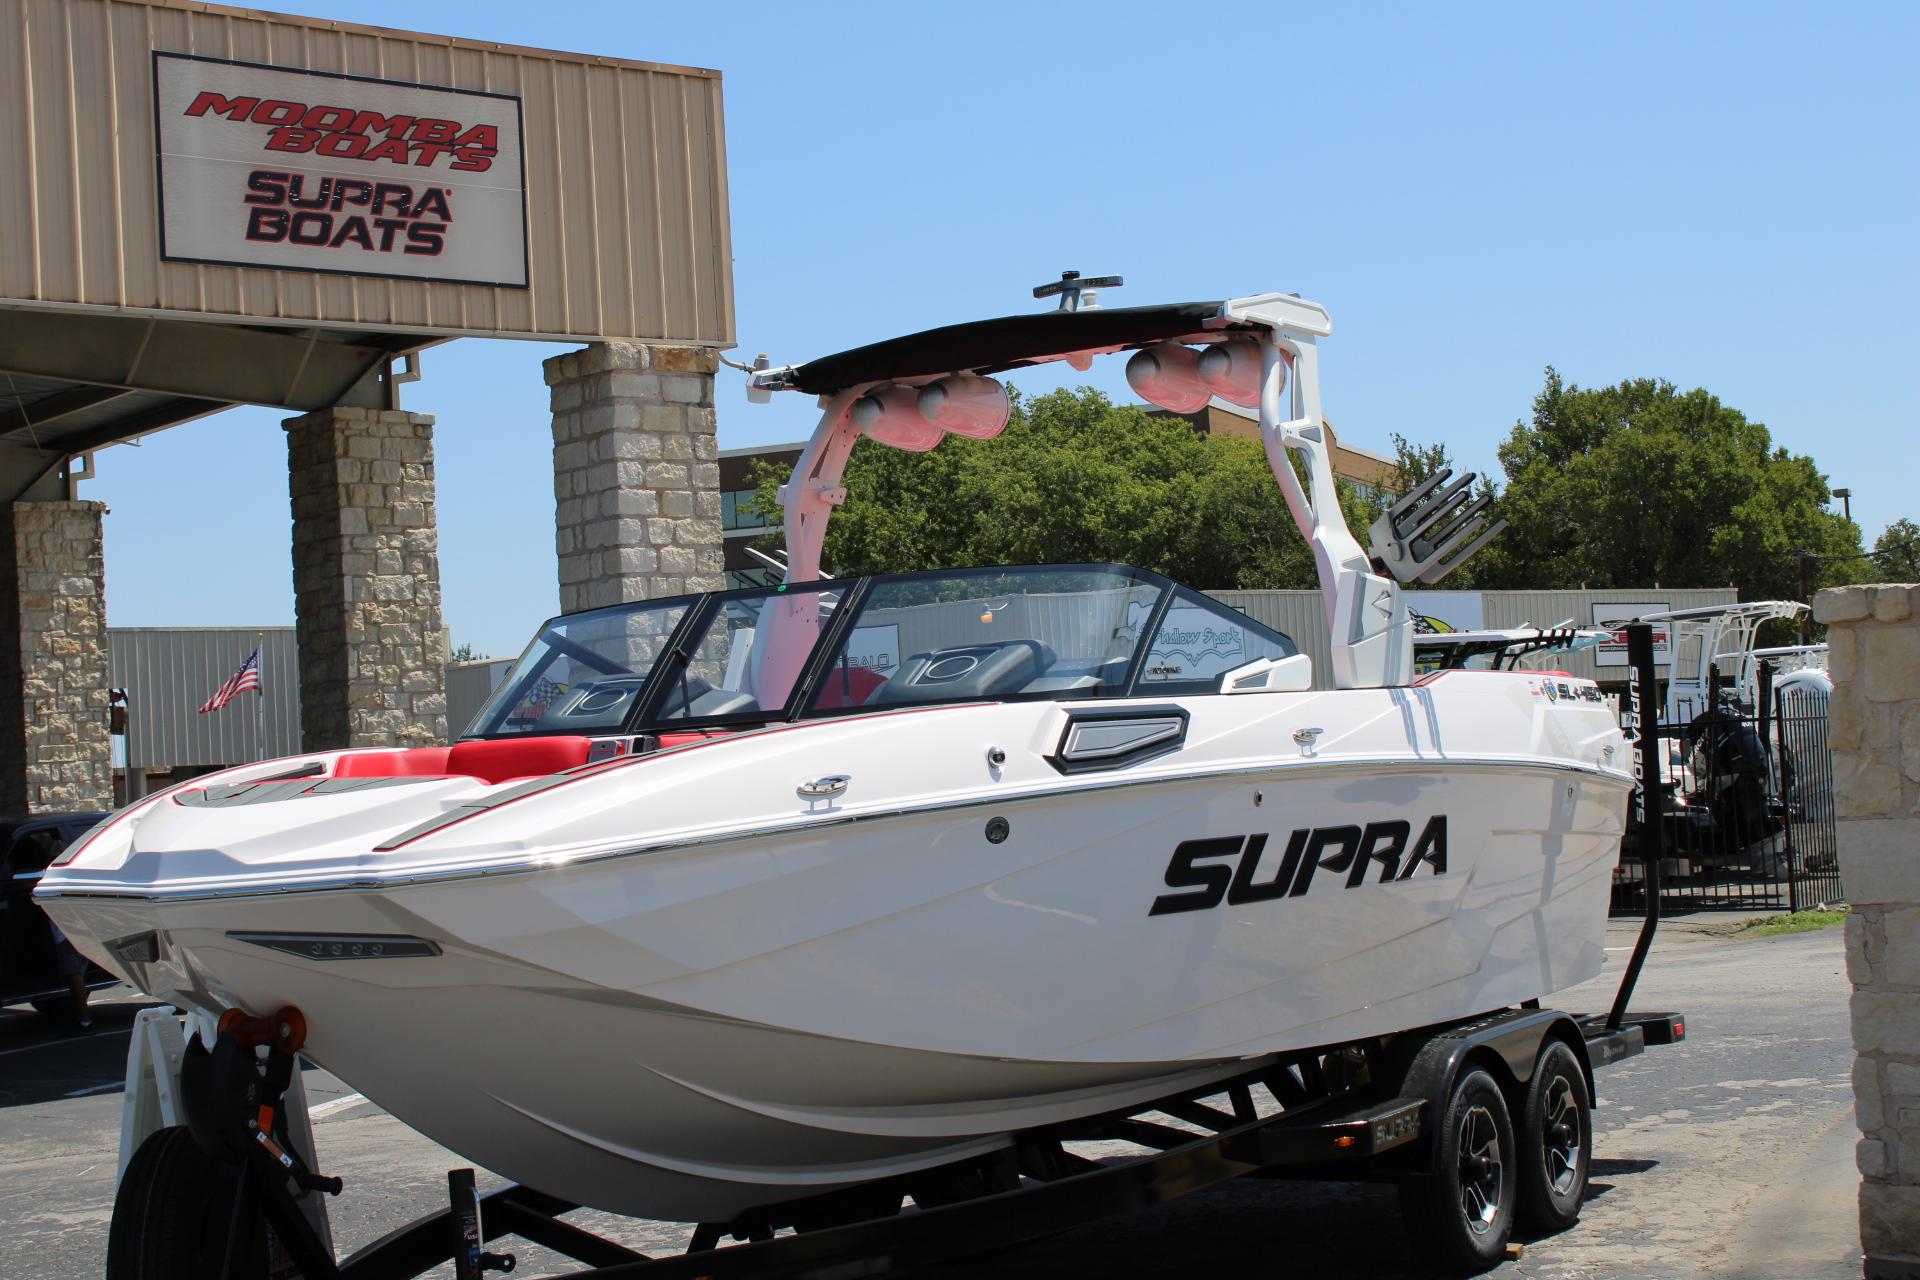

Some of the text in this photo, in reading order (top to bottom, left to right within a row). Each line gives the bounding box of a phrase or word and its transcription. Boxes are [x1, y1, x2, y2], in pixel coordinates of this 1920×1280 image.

[184, 91, 498, 150] MOOMBA
[264, 127, 498, 172] BOATS
[244, 170, 454, 222] SUPRA
[245, 207, 448, 257] BOATS
[1203, 626, 1241, 649] Sport
[1628, 665, 1645, 824] SUPRA BOATS
[1148, 815, 1447, 917] SUPRA
